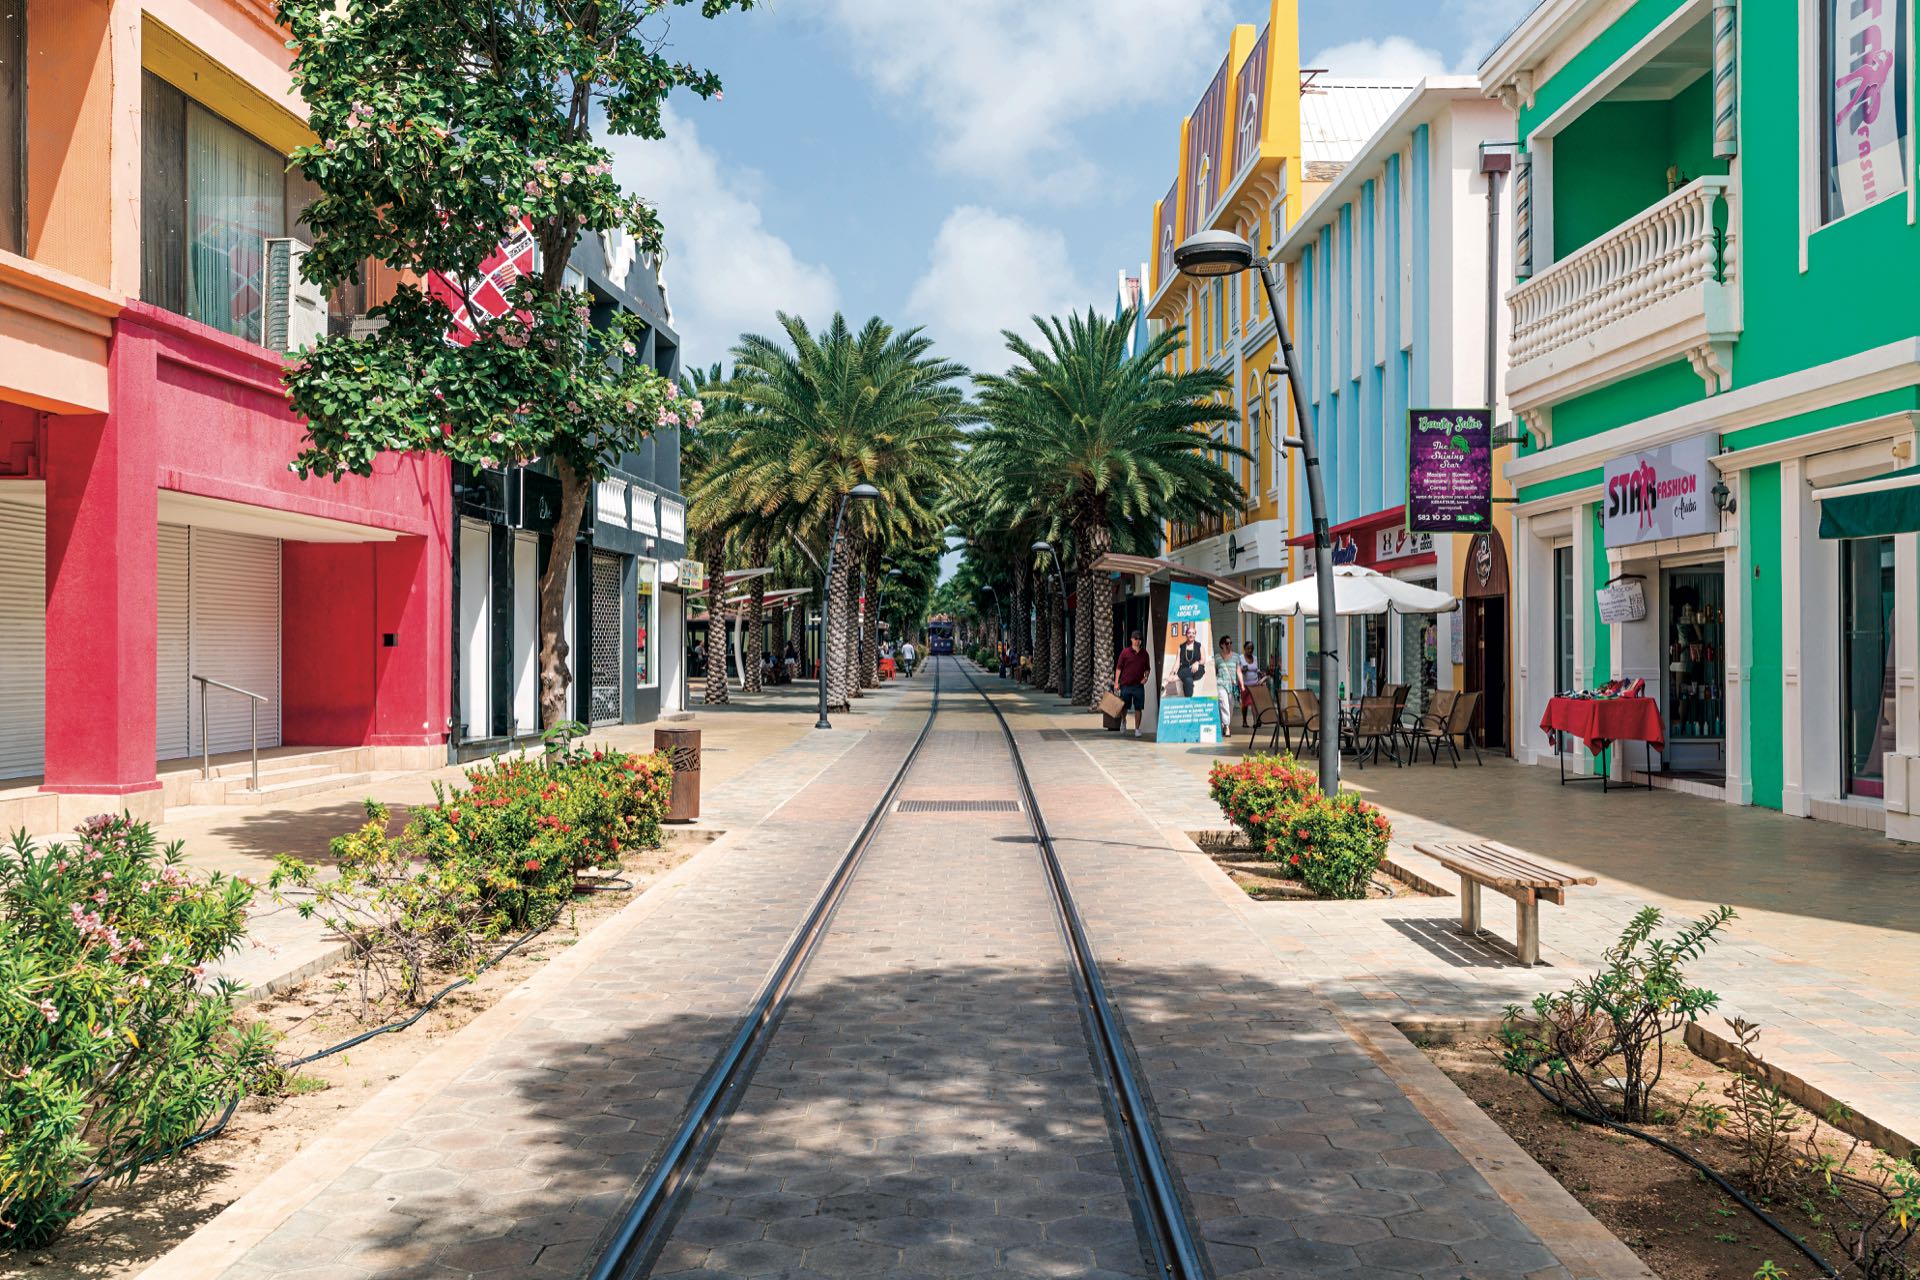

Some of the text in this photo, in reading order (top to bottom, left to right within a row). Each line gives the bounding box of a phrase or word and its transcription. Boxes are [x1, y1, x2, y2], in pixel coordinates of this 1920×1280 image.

[1857, 125, 1877, 202] FASHI
[1418, 416, 1453, 436] Beauty
[1432, 441, 1449, 450] The
[1431, 451, 1464, 461] Shining
[1439, 460, 1460, 469] Star
[1608, 467, 1697, 518] STAR FASHION
[1674, 497, 1697, 520] Aruba
[1192, 609, 1201, 617] TIP
